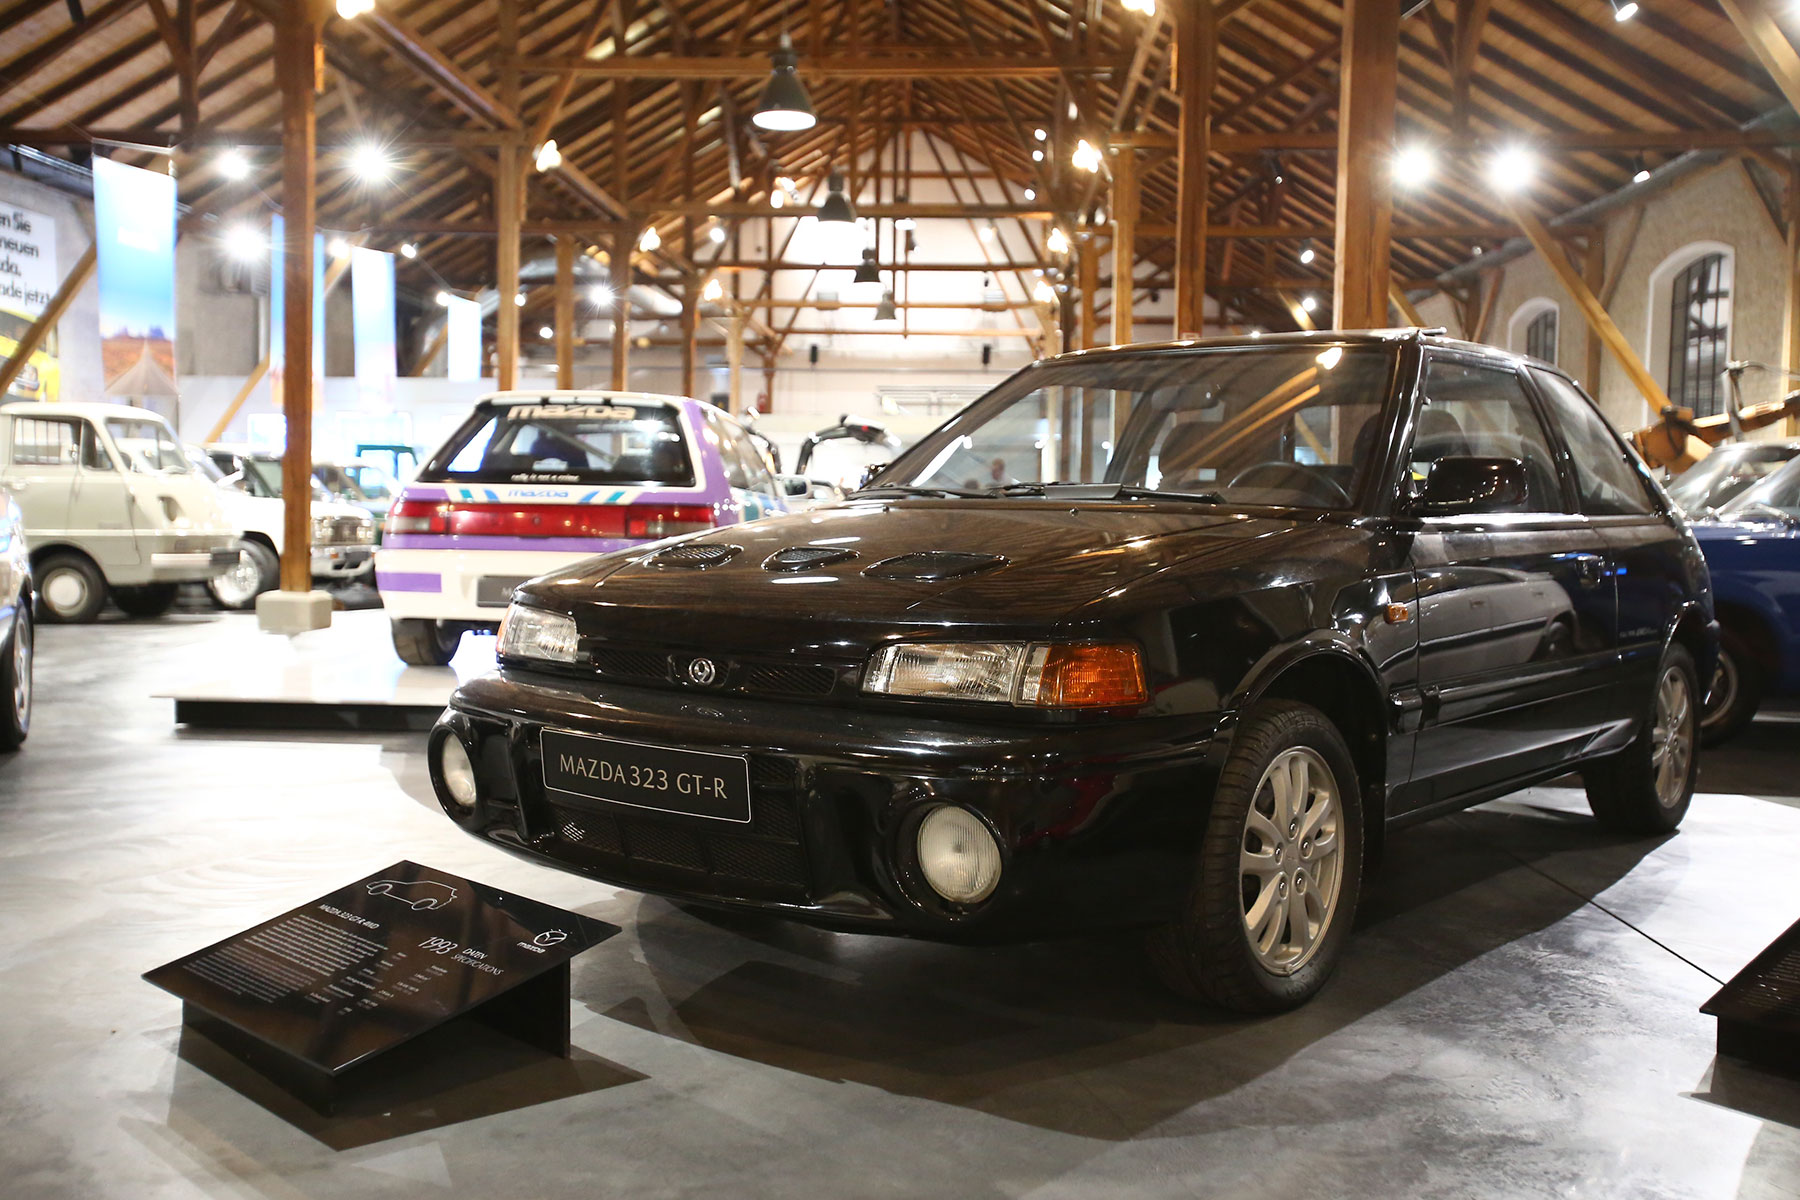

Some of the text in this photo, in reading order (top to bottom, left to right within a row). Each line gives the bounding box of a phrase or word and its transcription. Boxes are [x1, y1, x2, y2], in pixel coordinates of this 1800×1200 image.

[13, 212, 31, 233] Sie
[560, 753, 728, 799] MAZDA 323 GT-R
[418, 936, 458, 955] 1993
[462, 947, 488, 960] DATEN
[450, 953, 504, 976] SPECIFICATIONS
